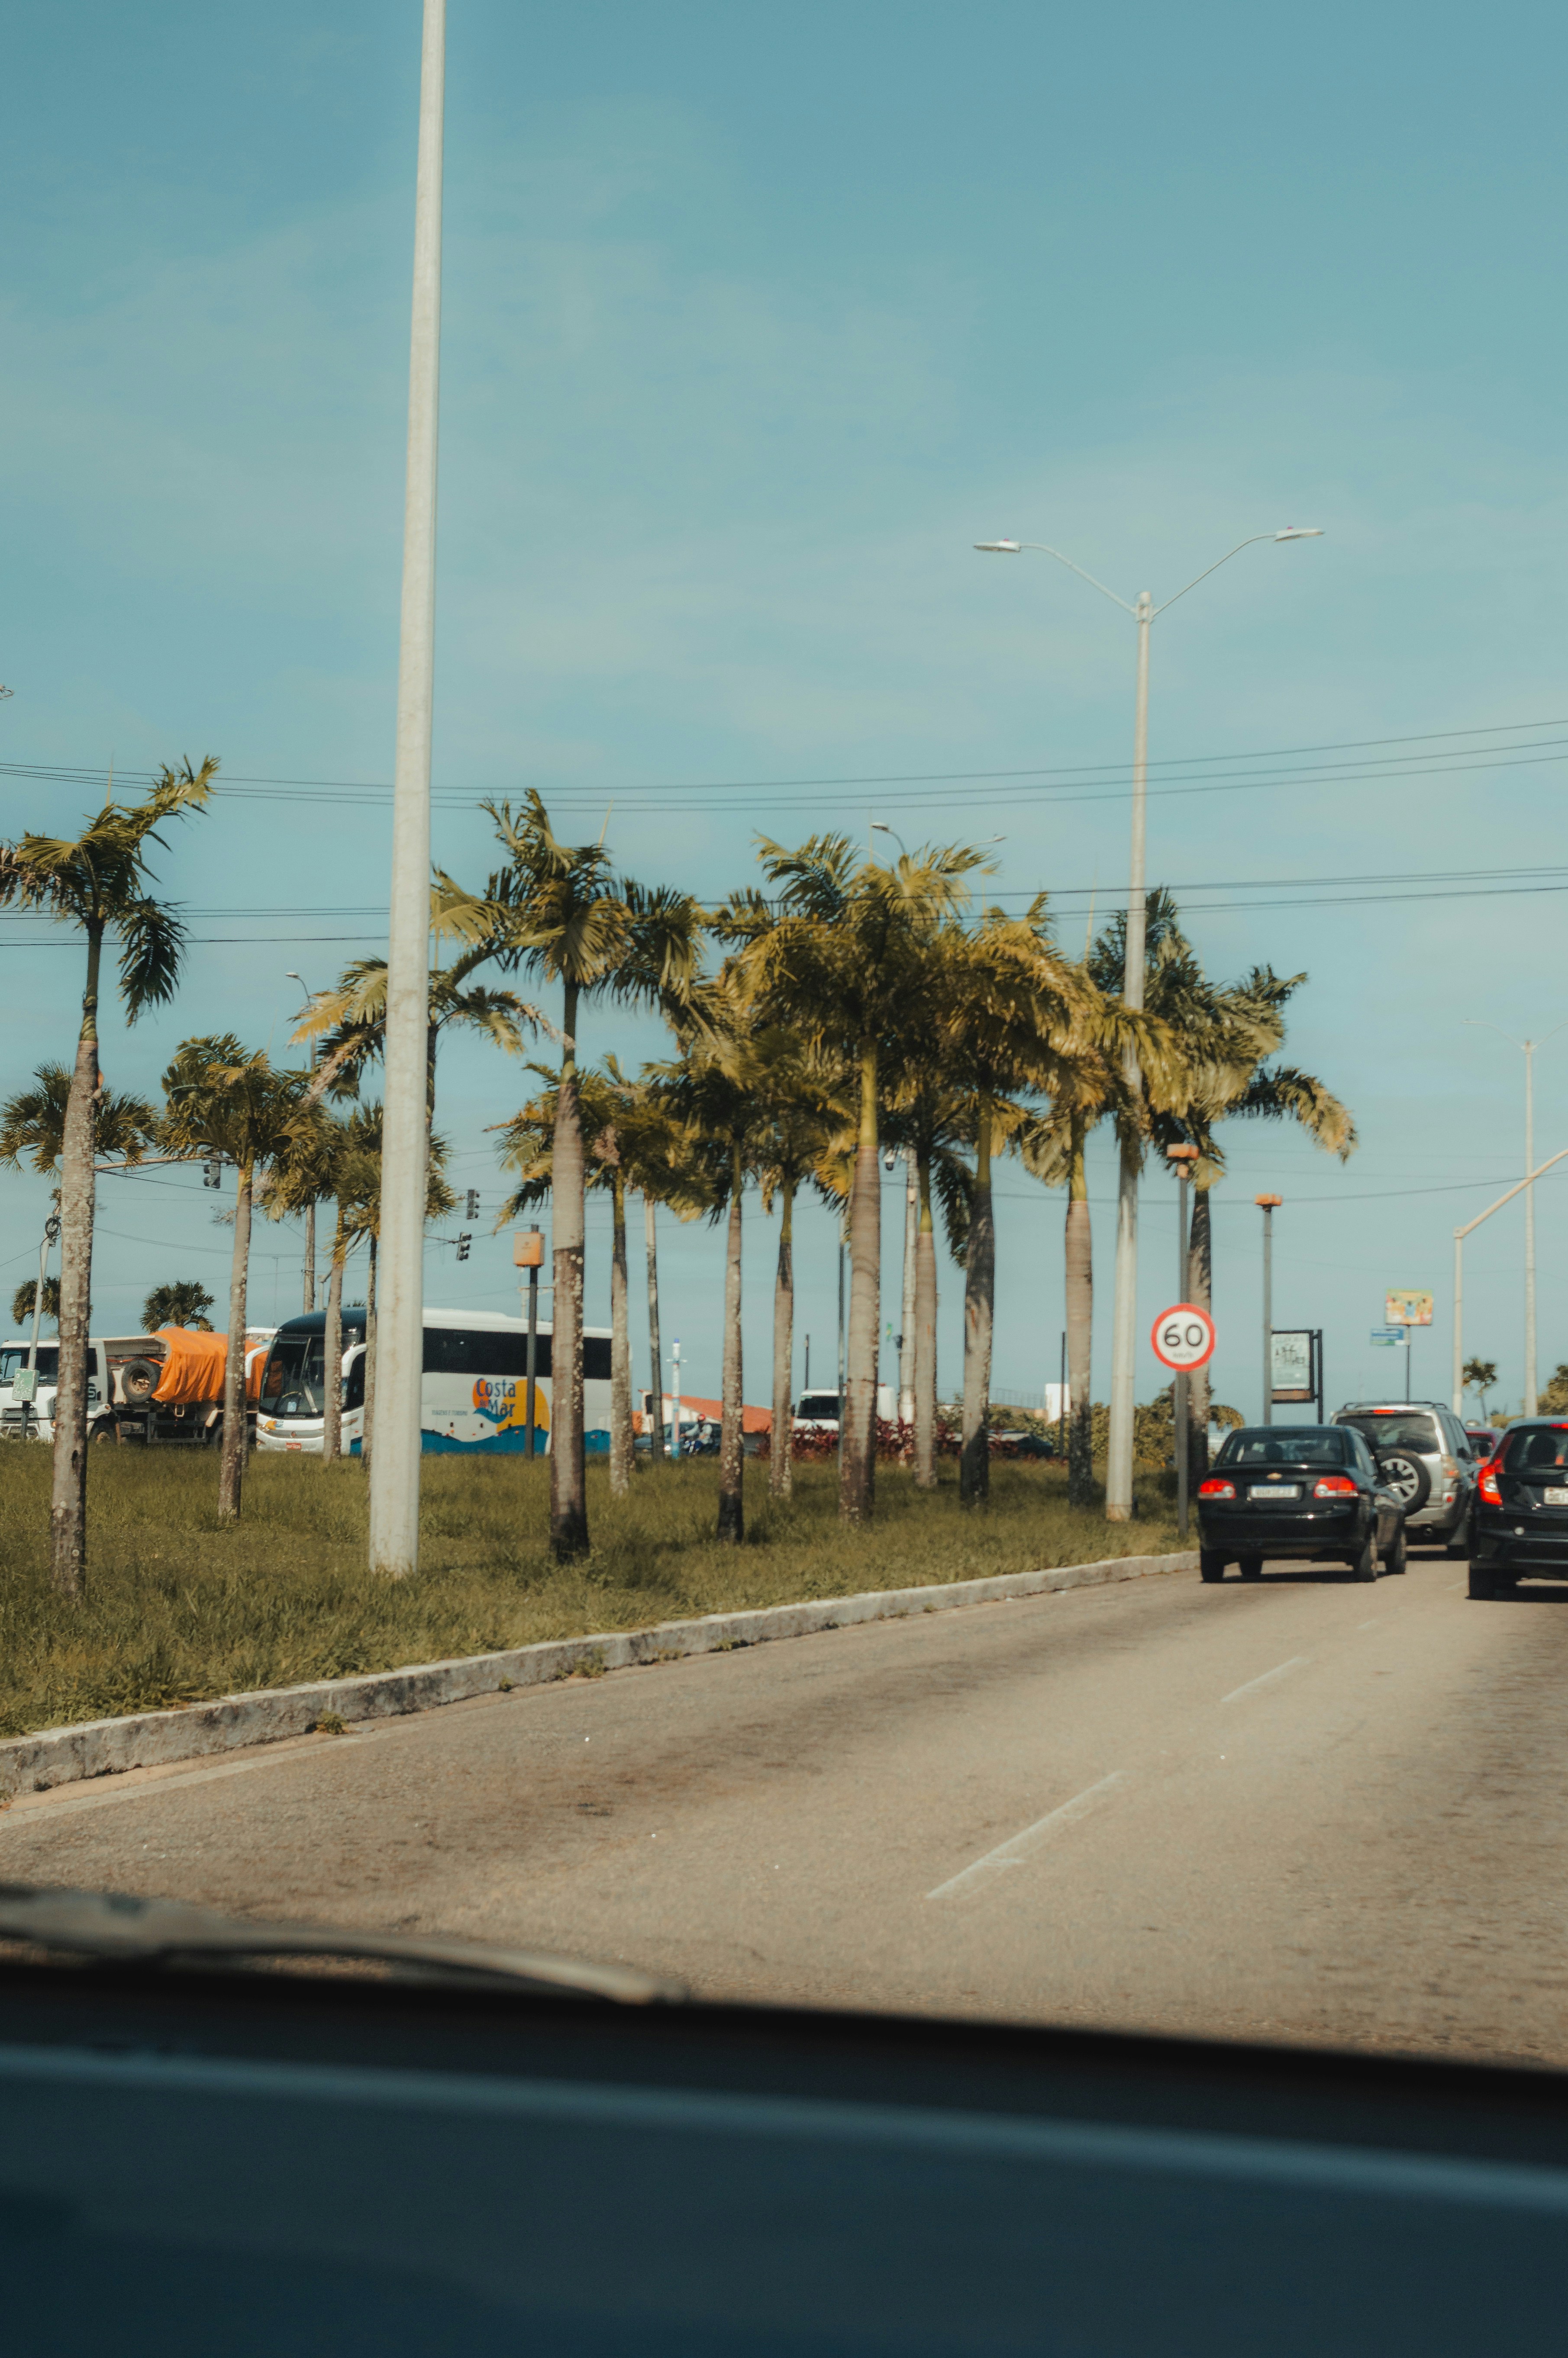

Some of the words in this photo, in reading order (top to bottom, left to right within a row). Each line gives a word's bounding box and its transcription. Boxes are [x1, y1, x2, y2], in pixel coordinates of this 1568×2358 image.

[1164, 1324, 1203, 1347] 60
[476, 1378, 516, 1397] Costa
[488, 1399, 515, 1417] Mar
